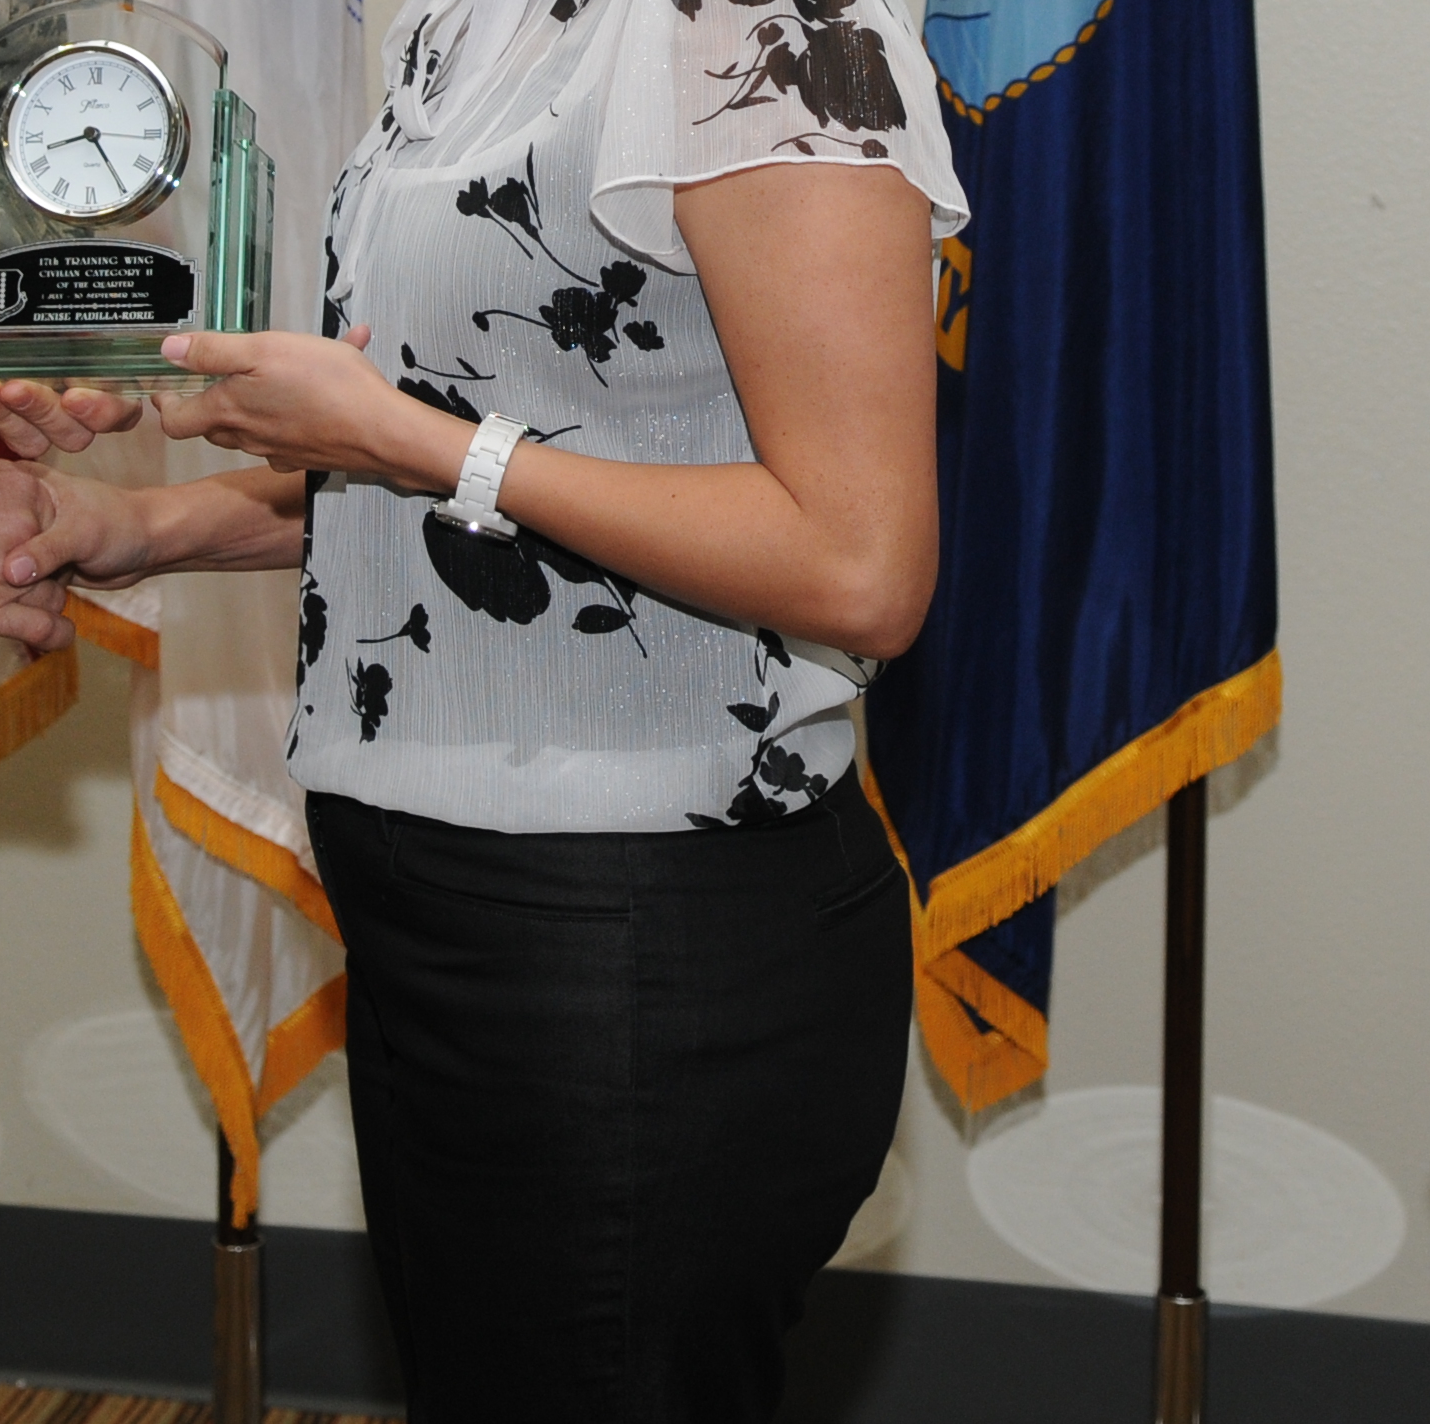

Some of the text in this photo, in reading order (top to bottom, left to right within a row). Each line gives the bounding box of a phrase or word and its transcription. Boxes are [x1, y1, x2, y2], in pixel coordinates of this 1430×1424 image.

[39, 256, 154, 266] 17th TRAINING WING
[38, 269, 80, 278] CIVILIAN
[85, 268, 141, 277] CATEGORY
[56, 280, 135, 289] OF THE QUARTER
[33, 312, 71, 322] DENISE
